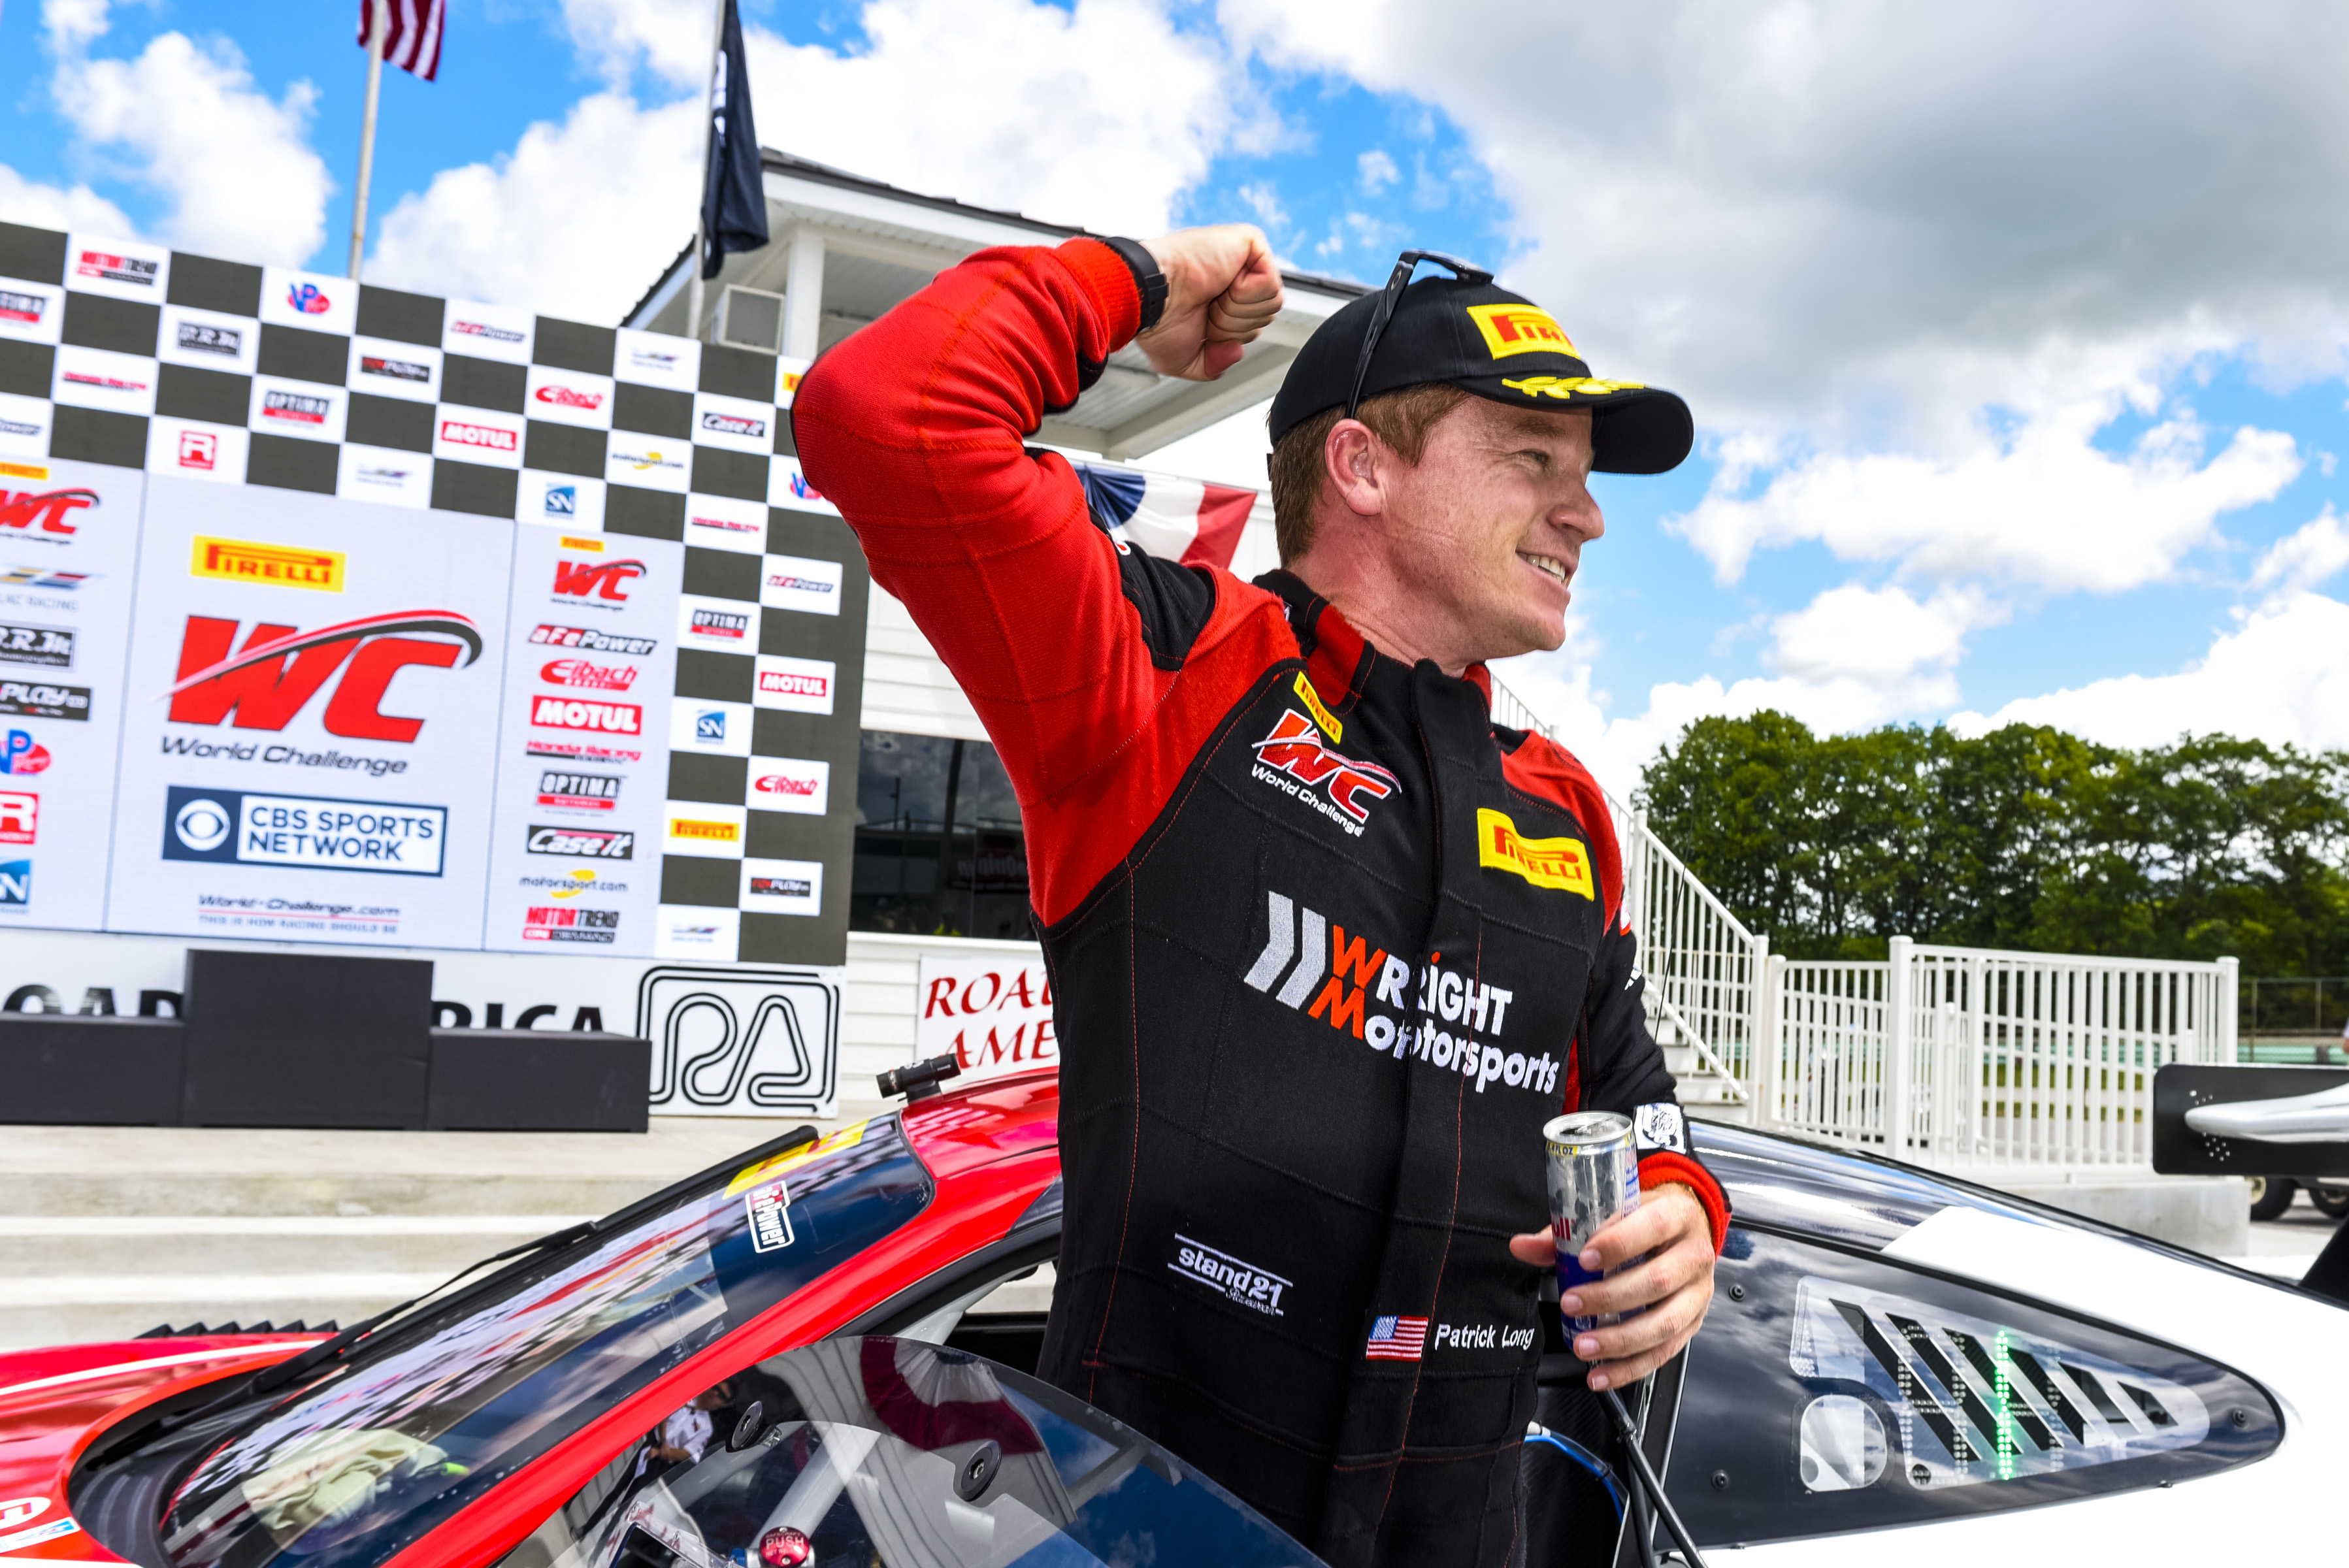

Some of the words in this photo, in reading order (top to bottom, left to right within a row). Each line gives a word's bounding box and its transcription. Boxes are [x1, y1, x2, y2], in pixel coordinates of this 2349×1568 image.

[445, 425, 514, 449] MOTUL
[205, 543, 333, 583] PIRELLI
[168, 614, 463, 743] WC
[761, 674, 825, 696] MOTUL
[535, 699, 638, 732] MOTUL
[161, 737, 257, 761] World
[262, 745, 408, 776] Challenge
[542, 773, 618, 798] OPTIMA
[1252, 763, 1300, 797] World
[1298, 788, 1364, 837] Challenge
[250, 807, 308, 834] CBS
[318, 812, 434, 840] SPORTS
[249, 834, 403, 861] NETWORK
[1434, 1323, 1496, 1350] Patrick
[1502, 1324, 1535, 1350] Long
[765, 1535, 804, 1550] PUSH
